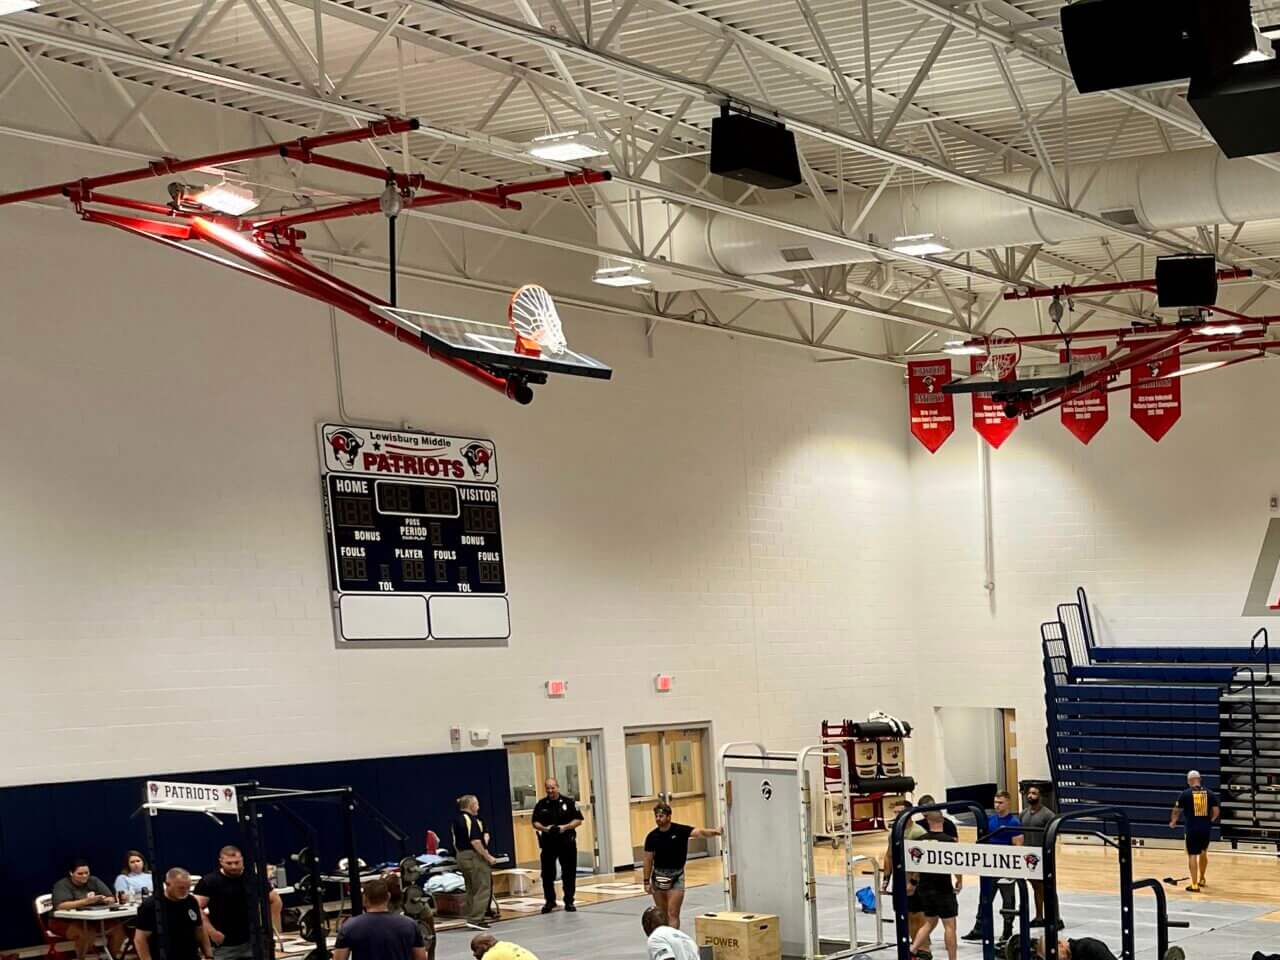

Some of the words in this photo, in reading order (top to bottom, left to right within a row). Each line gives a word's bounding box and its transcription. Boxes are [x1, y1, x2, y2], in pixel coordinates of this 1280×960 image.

[370, 431, 419, 445] Lewisburg
[421, 436, 452, 447] Middle
[363, 452, 465, 479] PATRIOTS
[336, 480, 369, 494] HOME
[459, 487, 498, 503] VISITOR
[405, 518, 421, 526] POSS
[354, 530, 381, 542] BONUS
[400, 526, 428, 537] PERIOD
[461, 535, 486, 546] BONUS
[340, 546, 366, 558] FOULS
[394, 548, 423, 559] PLAYER
[433, 550, 457, 561] FOULS
[478, 551, 500, 562] FOULS
[378, 581, 395, 592] TOL
[457, 583, 472, 593] TOL
[164, 785, 219, 801] PATRIOTS
[927, 849, 1022, 870] DISCIPLINE
[704, 936, 740, 949] POWER
